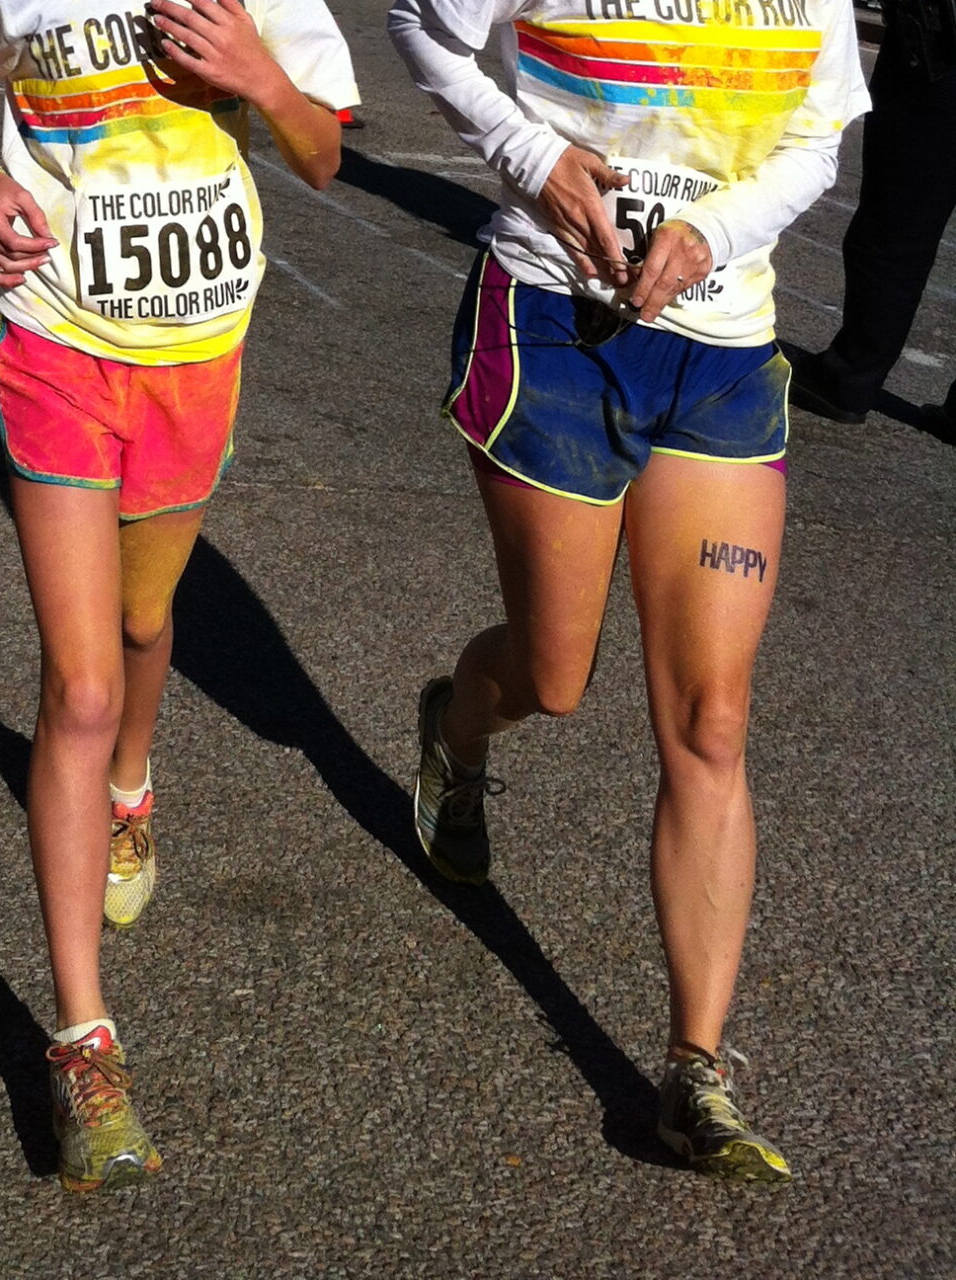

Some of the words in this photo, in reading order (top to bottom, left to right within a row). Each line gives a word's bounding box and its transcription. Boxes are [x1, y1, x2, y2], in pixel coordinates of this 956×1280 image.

[628, 168, 681, 199] COLOR
[89, 194, 126, 221] THE
[129, 189, 194, 219] COLOR
[84, 202, 252, 296] 15088
[97, 298, 134, 319] THE
[137, 291, 201, 318] COLOR
[203, 280, 237, 313] RUN
[700, 538, 767, 583] HAPPY
